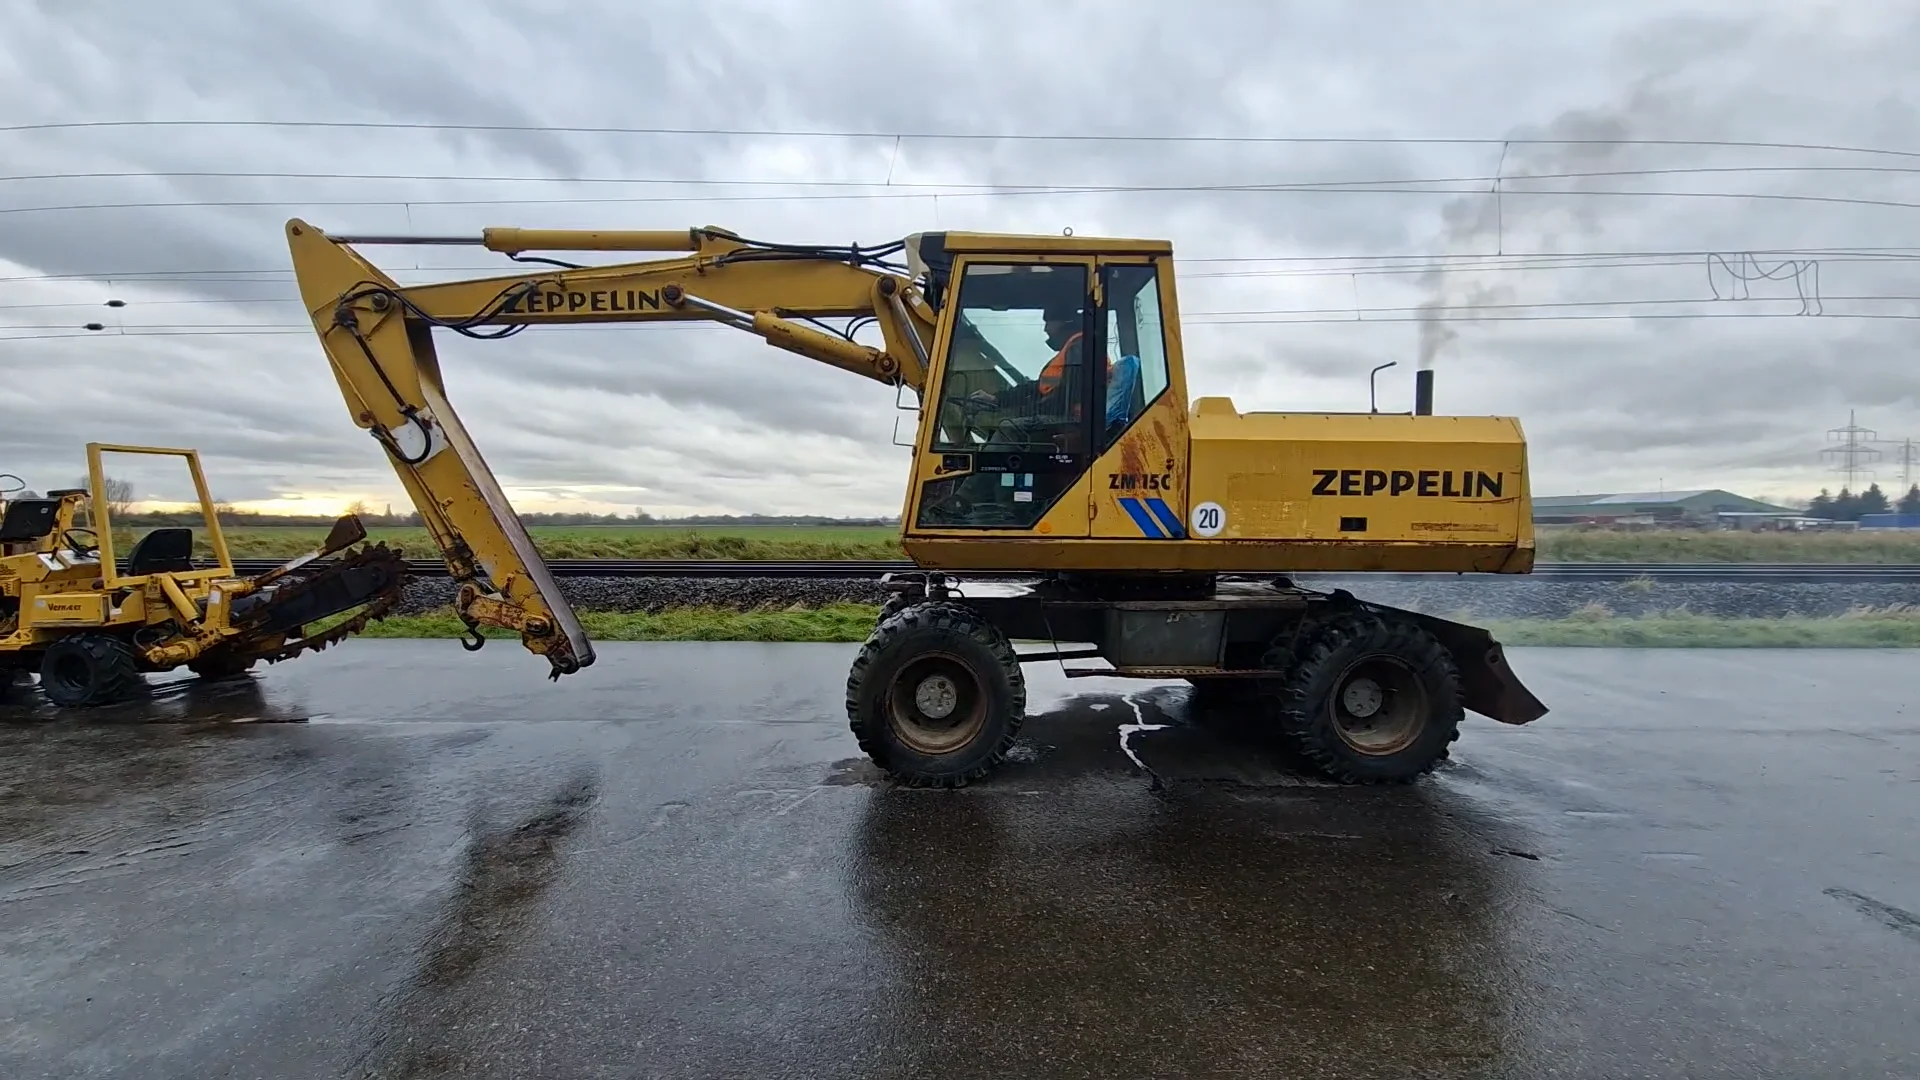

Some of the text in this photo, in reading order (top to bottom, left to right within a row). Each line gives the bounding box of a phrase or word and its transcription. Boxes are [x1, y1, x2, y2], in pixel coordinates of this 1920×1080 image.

[503, 289, 660, 314] ZEPPELIN
[1109, 473, 1171, 491] ZM 15C
[1312, 469, 1503, 498] ZEPPELIN
[1199, 508, 1219, 529] 20
